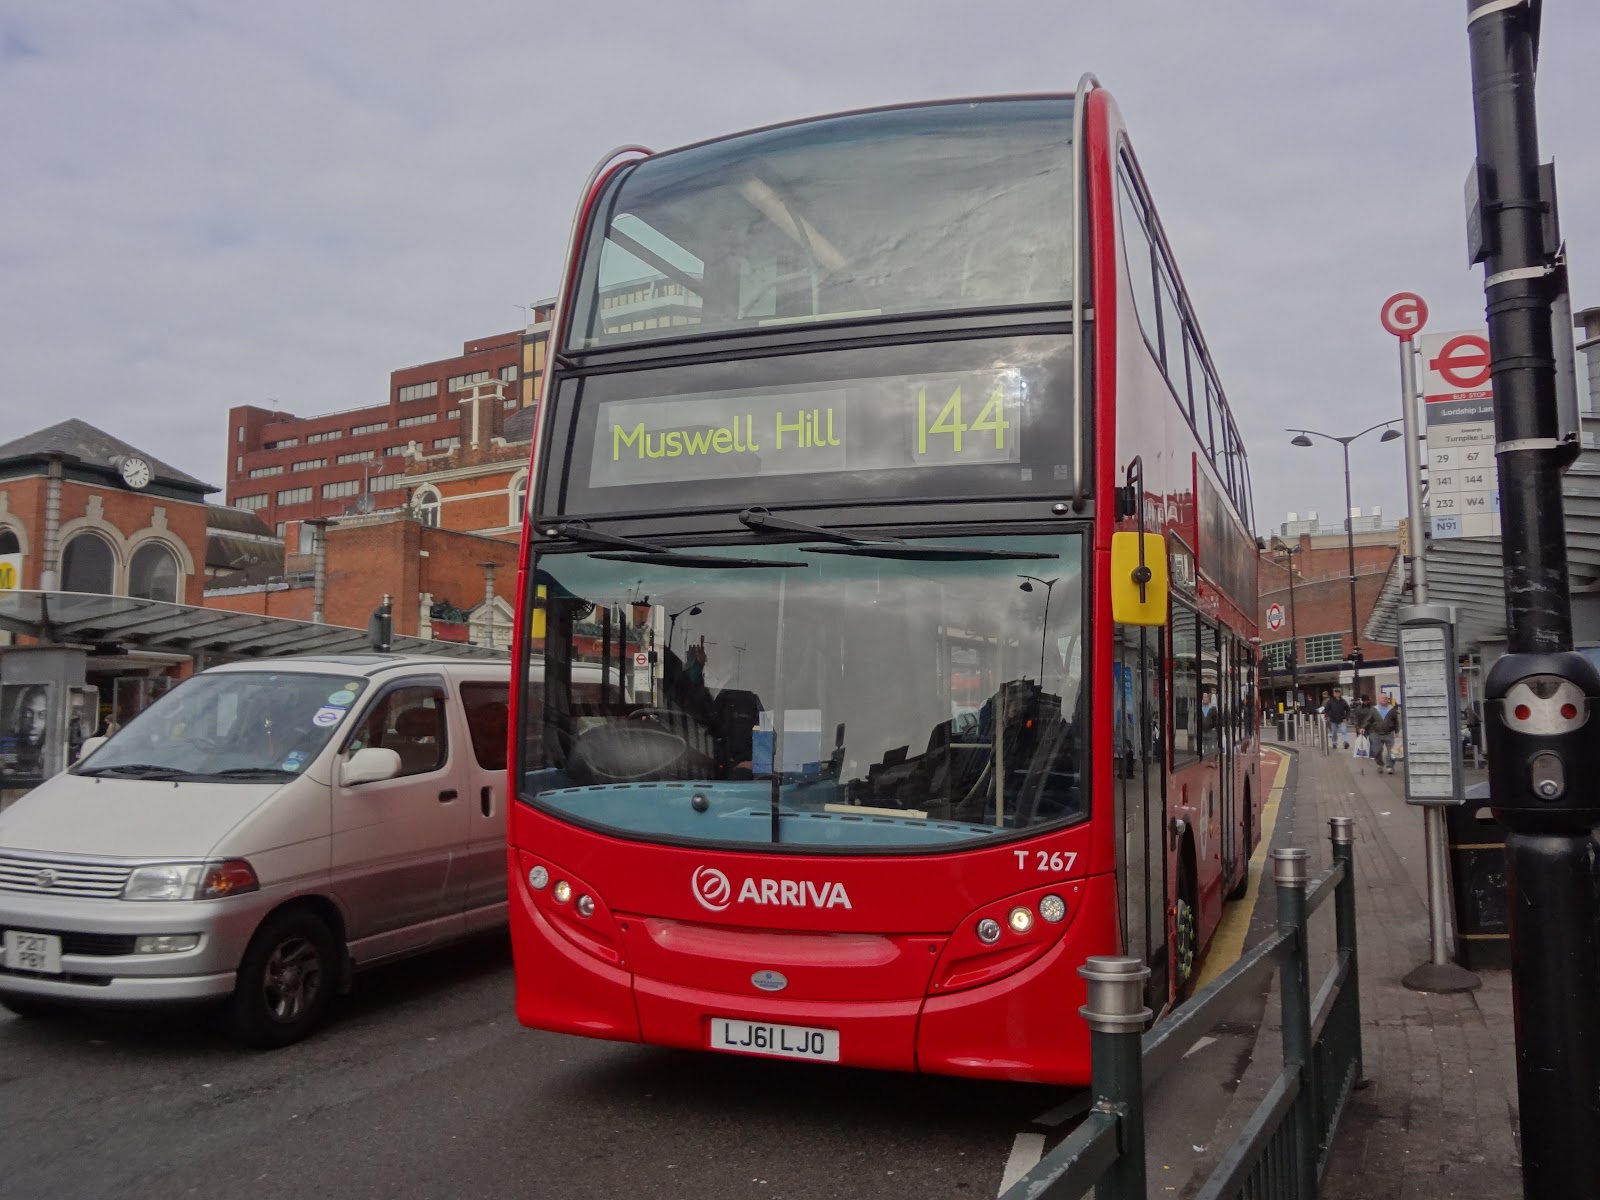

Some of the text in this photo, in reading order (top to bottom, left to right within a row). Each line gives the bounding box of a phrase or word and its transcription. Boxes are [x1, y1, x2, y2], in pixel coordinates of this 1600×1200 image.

[1387, 299, 1419, 330] G
[1442, 407, 1477, 417] Lordship
[613, 384, 1010, 461] Muswell Hill 144
[1436, 452, 1480, 463] 29 67
[1436, 475, 1483, 486] 141 144
[1436, 499, 1454, 508] 232
[1466, 497, 1485, 506] W4
[1436, 521, 1457, 531] N91
[1014, 850, 1078, 872] T 267
[737, 877, 853, 909] ARRIVA
[725, 1022, 825, 1055] LJ61 LJO
